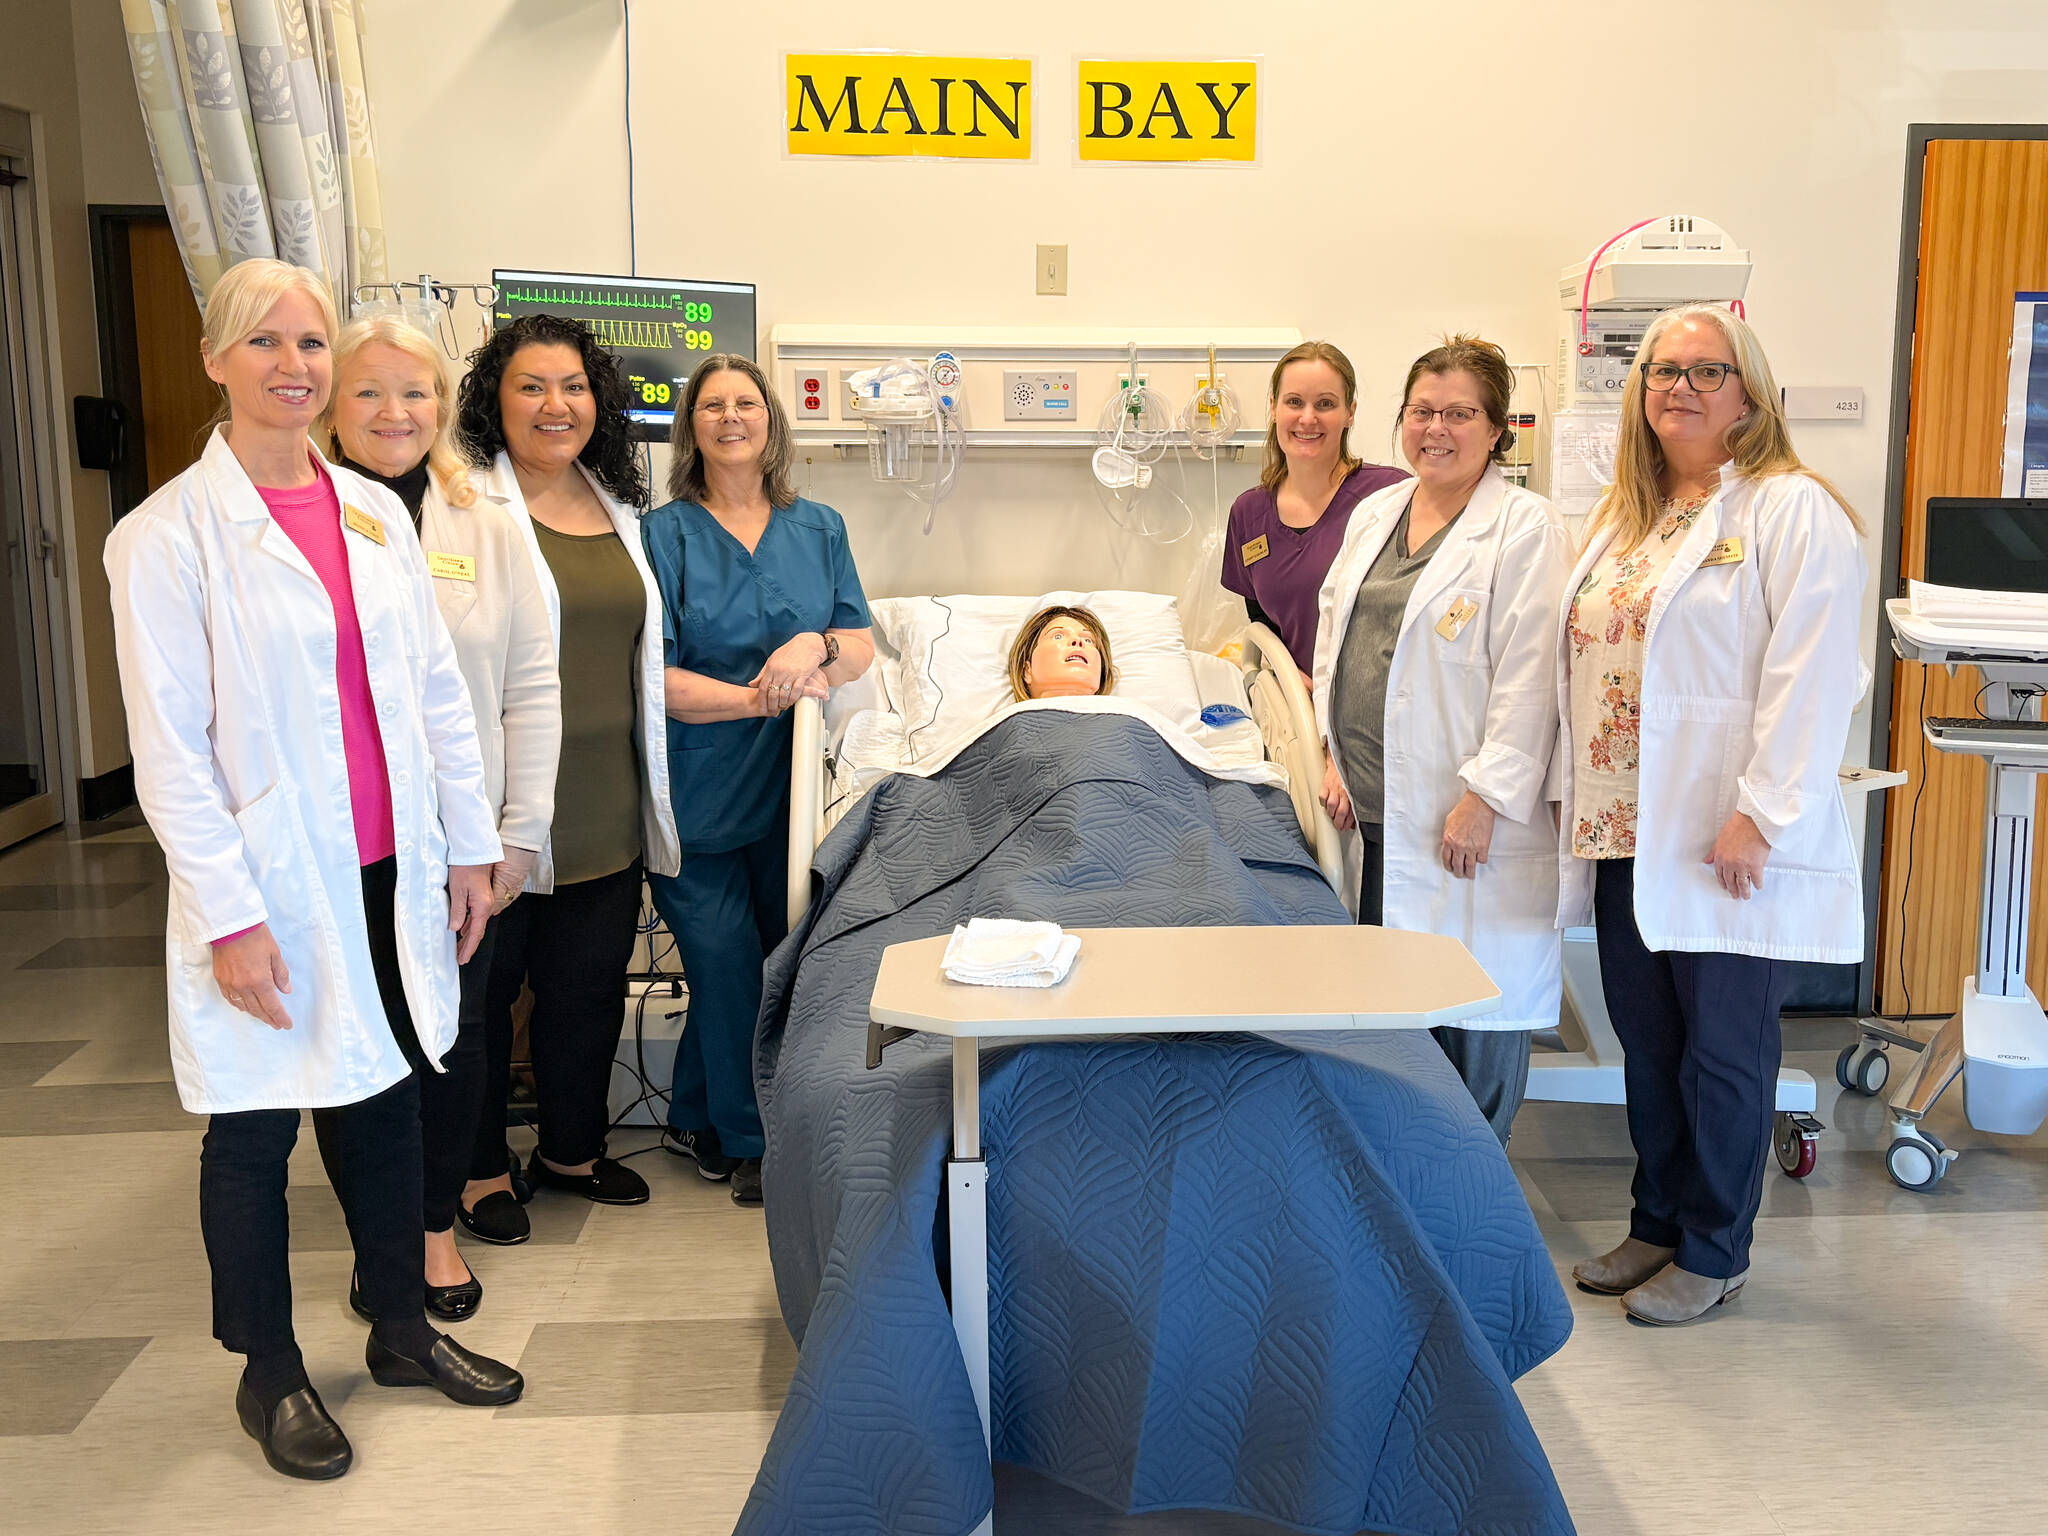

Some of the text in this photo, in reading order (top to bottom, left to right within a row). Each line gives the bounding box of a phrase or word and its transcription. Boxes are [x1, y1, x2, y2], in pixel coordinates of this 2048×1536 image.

[790, 74, 1251, 140] MAIN BAY
[684, 302, 713, 324] 89
[684, 329, 713, 351] 99
[642, 382, 671, 404] 89
[1835, 401, 1859, 411] 4233
